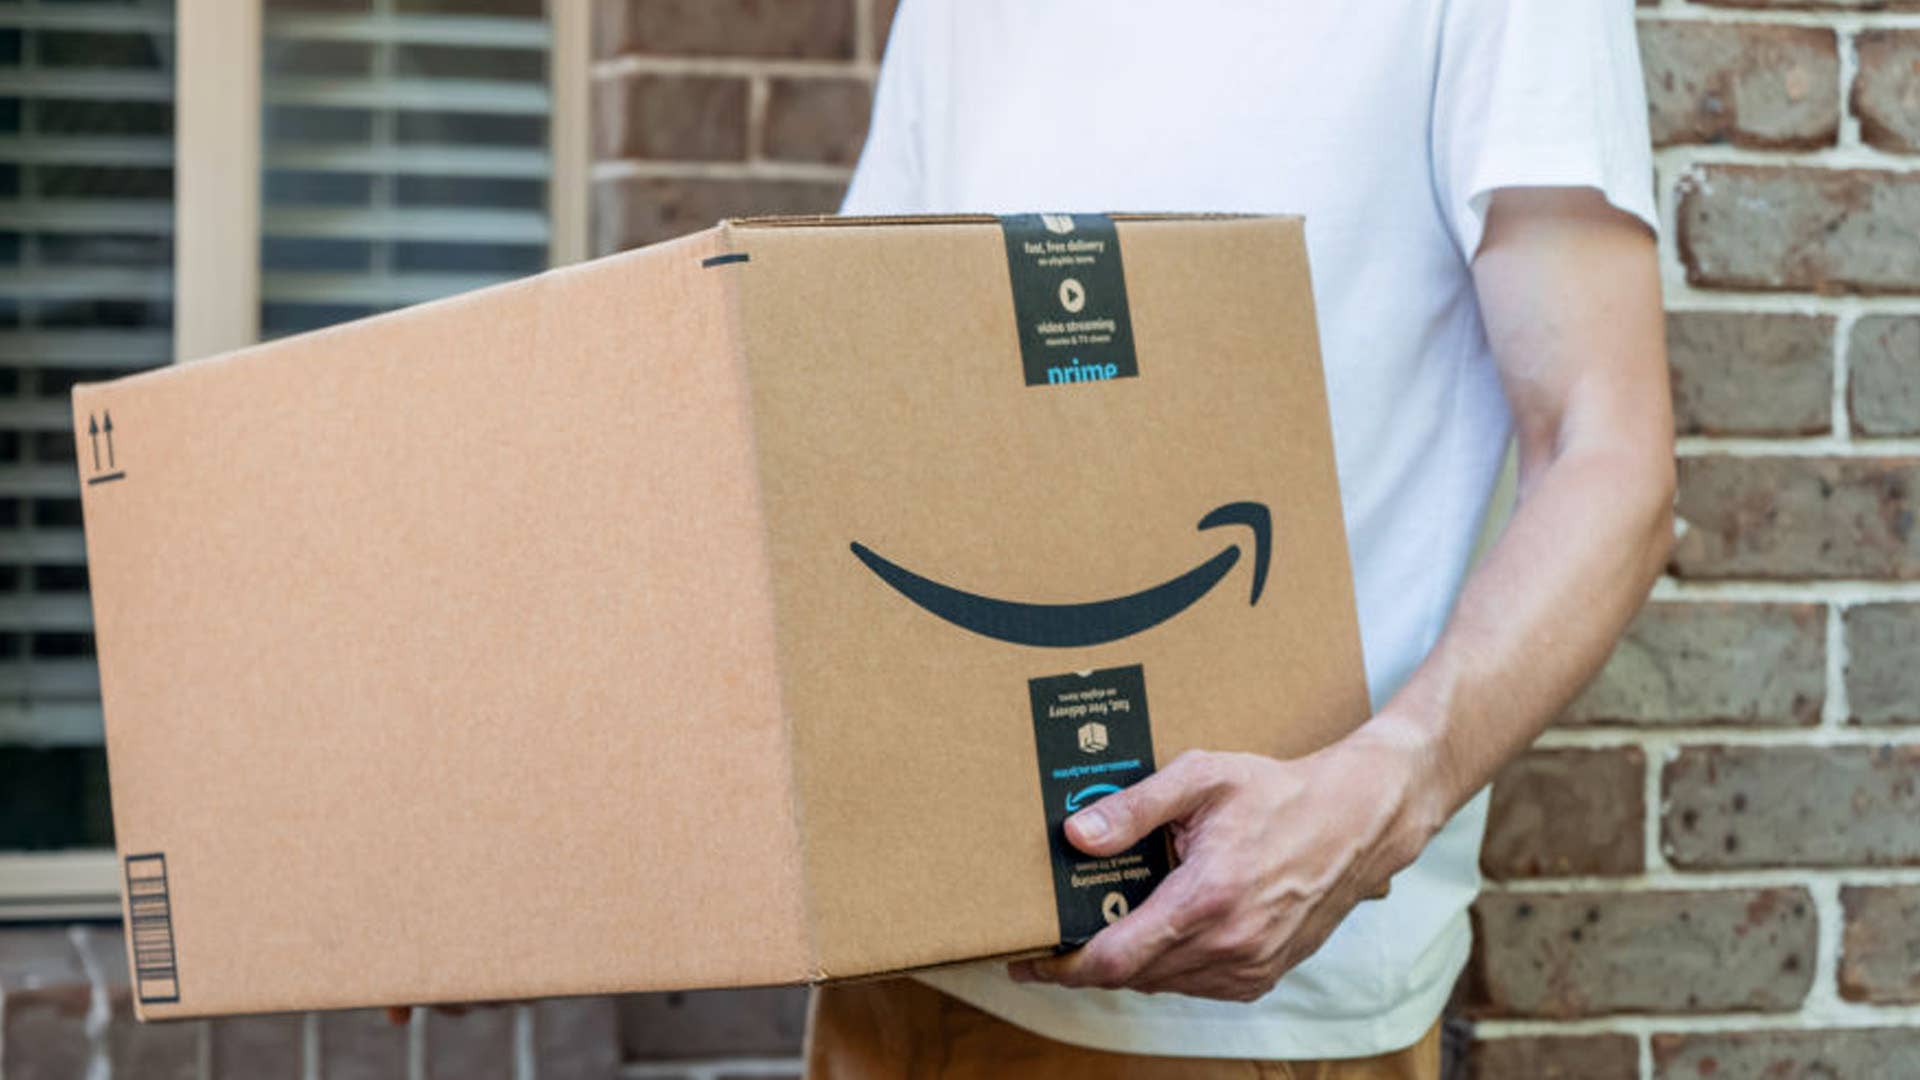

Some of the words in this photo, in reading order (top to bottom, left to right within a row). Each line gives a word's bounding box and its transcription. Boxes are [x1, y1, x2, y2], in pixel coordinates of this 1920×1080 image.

[1025, 241, 1046, 255] fast,
[1046, 240, 1065, 254] free
[1067, 239, 1104, 253] delivery
[1037, 321, 1064, 334] video
[1066, 318, 1117, 333] streaming
[1047, 358, 1118, 385] prime
[1049, 704, 1087, 718] delivery
[1088, 702, 1107, 715] free
[1071, 872, 1121, 888] streaming
[1123, 867, 1151, 881] video
